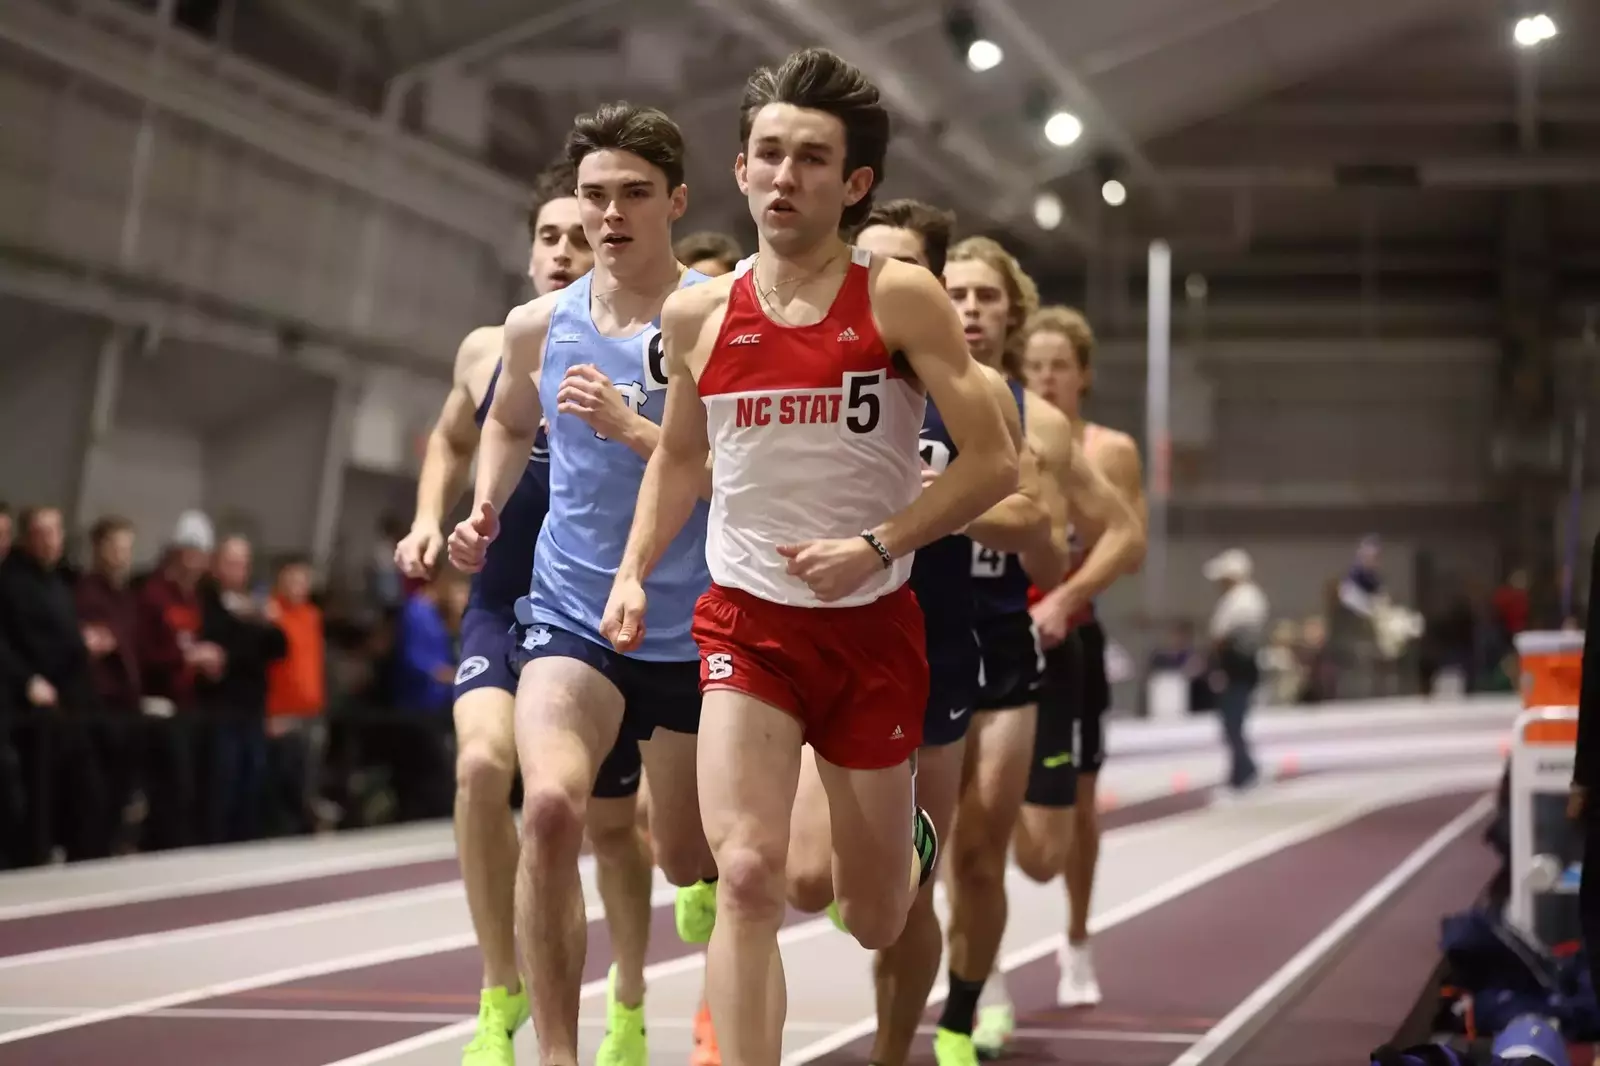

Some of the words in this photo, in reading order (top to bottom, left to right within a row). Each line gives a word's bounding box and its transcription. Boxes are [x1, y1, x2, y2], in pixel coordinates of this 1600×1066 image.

[728, 333, 762, 345] ACC
[736, 397, 771, 428] NC
[846, 374, 880, 434] 5
[977, 547, 1000, 572] 4
